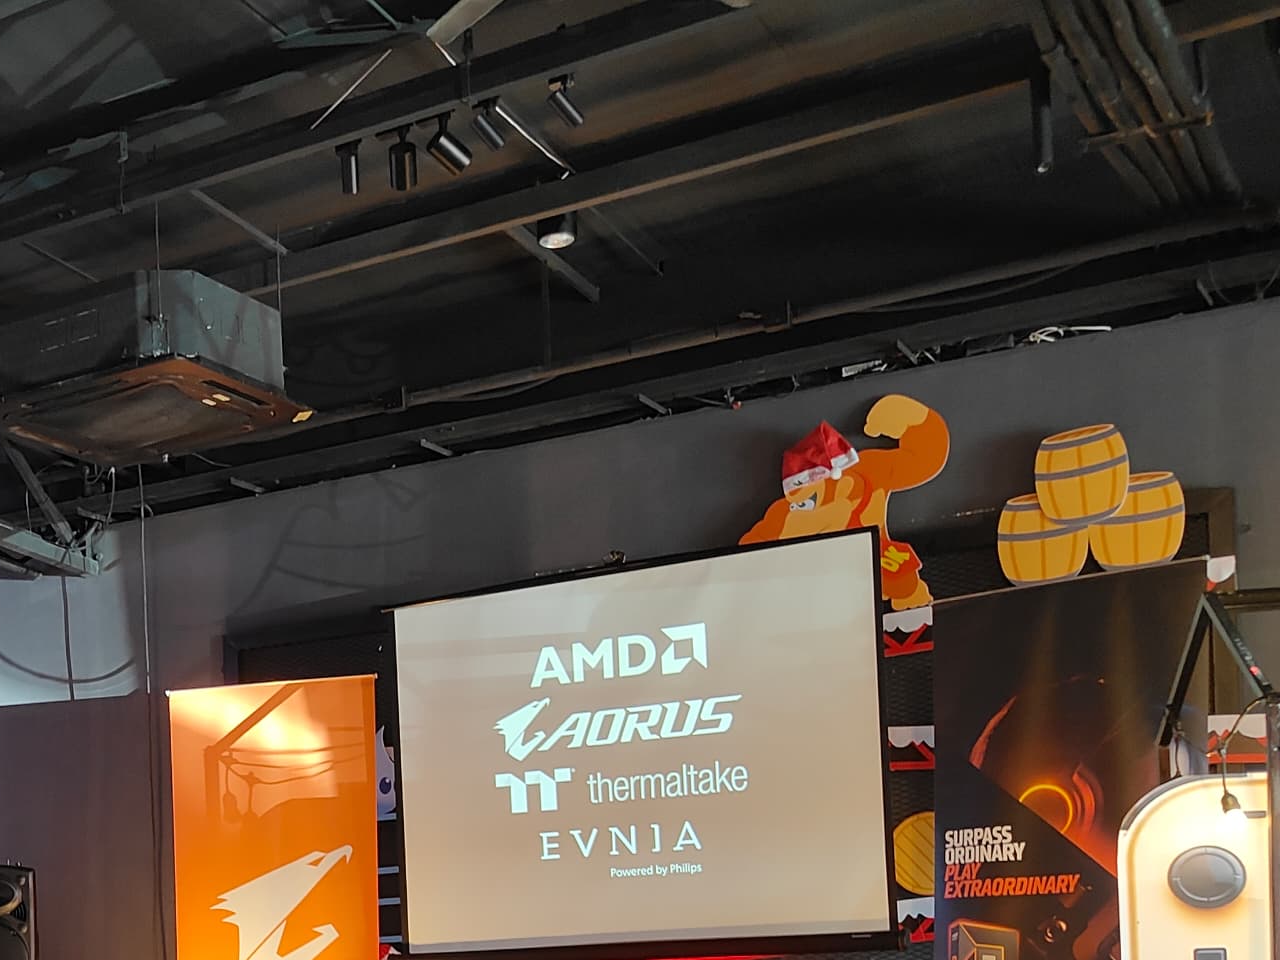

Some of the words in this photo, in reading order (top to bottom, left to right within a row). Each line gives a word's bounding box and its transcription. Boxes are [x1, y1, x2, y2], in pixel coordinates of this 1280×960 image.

[530, 634, 657, 688] AMD
[536, 694, 743, 751] AORUS
[586, 760, 748, 804] thermaltake
[539, 820, 702, 860] EVNIA
[944, 825, 1013, 848] SURPASS
[944, 842, 1026, 865] ORDINARY
[610, 865, 653, 878] Powered
[655, 864, 669, 877] by
[669, 862, 703, 876] Philips
[944, 862, 982, 881] PLAY
[944, 874, 1081, 899] EXTRAORDINARY
